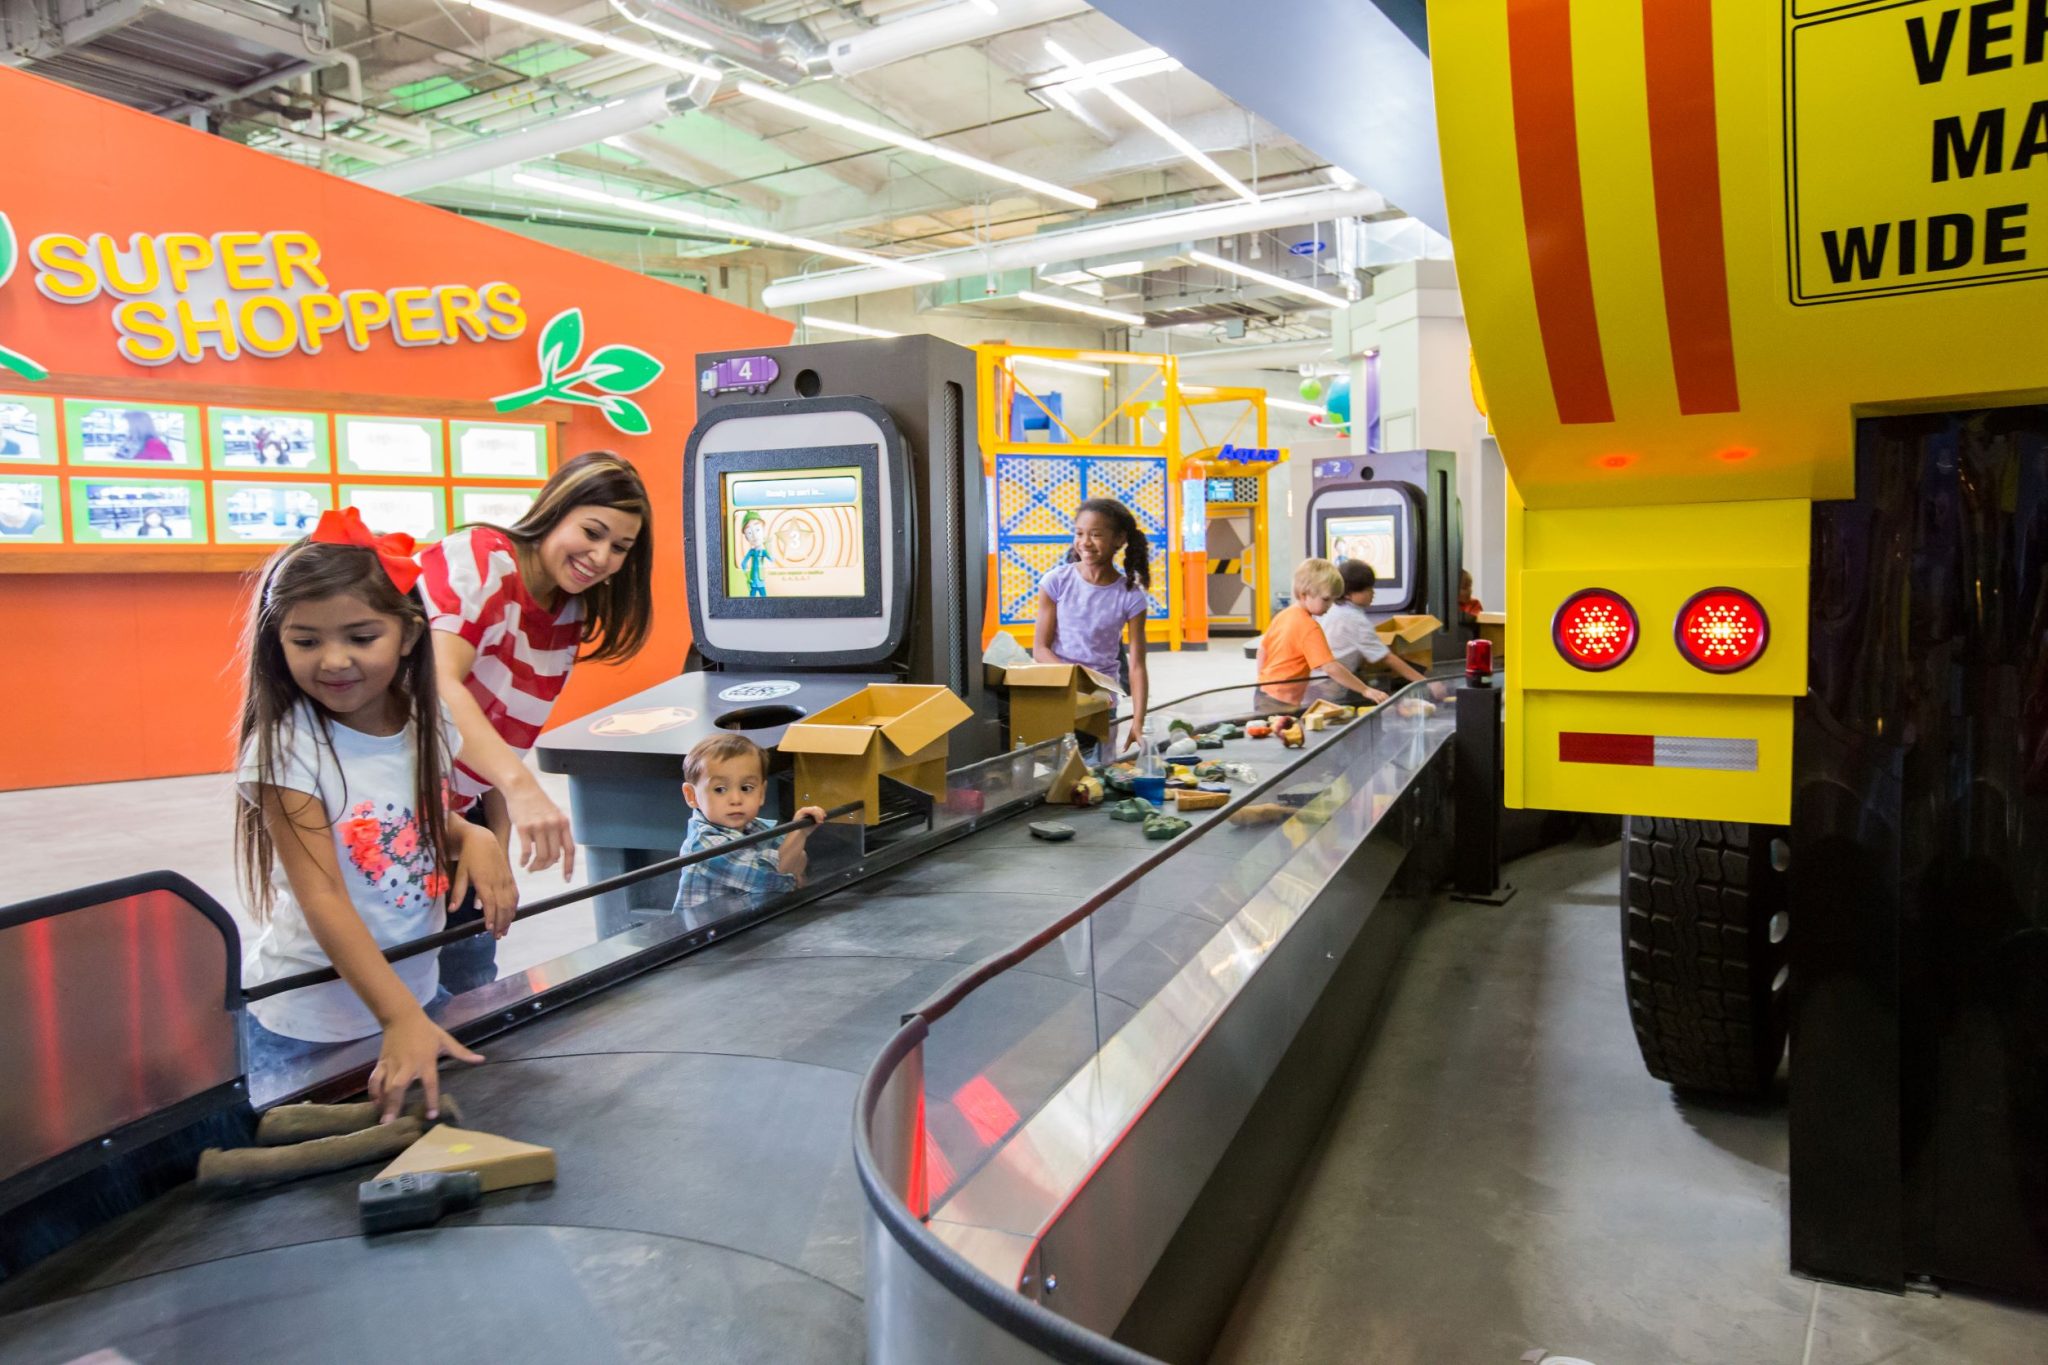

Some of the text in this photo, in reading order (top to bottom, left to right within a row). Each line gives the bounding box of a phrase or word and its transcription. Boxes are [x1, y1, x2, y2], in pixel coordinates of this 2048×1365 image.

[1821, 203, 2029, 284] WIDE
[35, 231, 329, 299] SUPER
[117, 282, 529, 363] SHOPPERS
[738, 360, 753, 381] 4
[1217, 444, 1280, 465] Aqua
[1332, 461, 1341, 473] 2
[790, 531, 800, 548] 3
